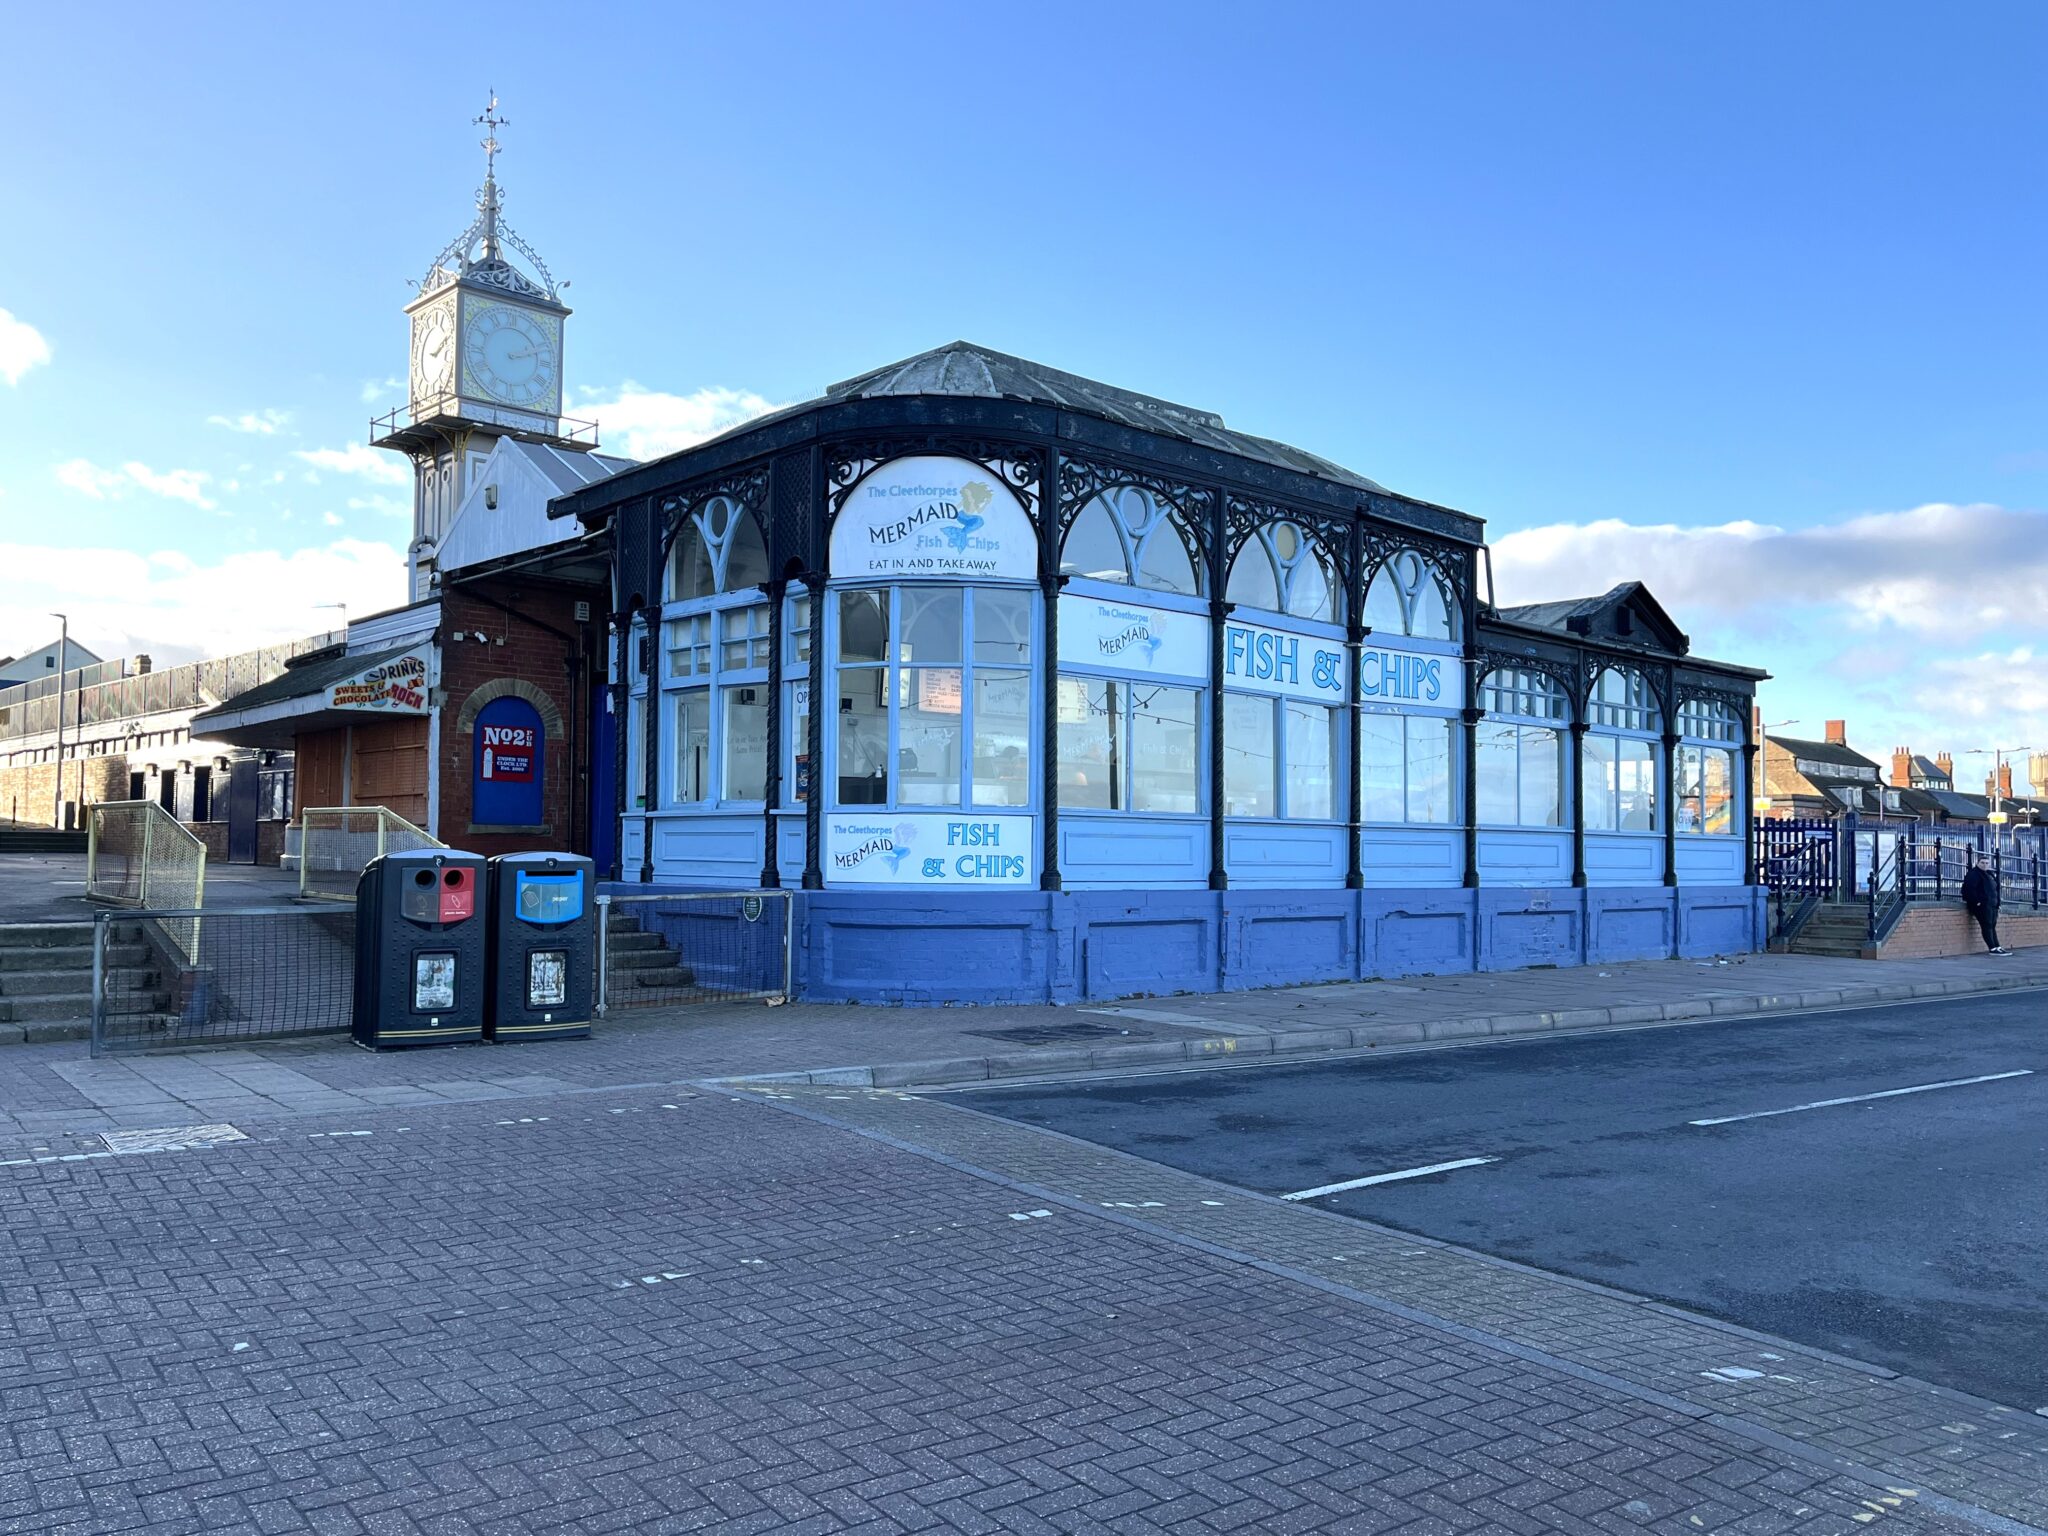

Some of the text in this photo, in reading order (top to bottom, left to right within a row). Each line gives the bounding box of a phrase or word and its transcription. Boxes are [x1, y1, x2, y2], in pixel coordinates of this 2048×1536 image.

[867, 485, 958, 498] The Cleethorpes
[869, 502, 959, 544] MERMAID
[917, 535, 942, 548] Fish
[966, 537, 1000, 551] Chips
[869, 559, 997, 571] EAT IN AND TAKEAWAY
[1098, 606, 1149, 623] The Cleethorpes
[1098, 626, 1149, 654] MERMAID
[379, 660, 425, 680] DRINKS
[1226, 626, 1441, 700] FISH & CHIPS
[335, 685, 375, 696] SWEETS
[391, 683, 425, 709] ROCK
[834, 825, 892, 835] The Cleethorpes
[947, 822, 1000, 847] FISH
[834, 838, 893, 867] MERMAID
[922, 855, 1024, 878] & CHIPS
